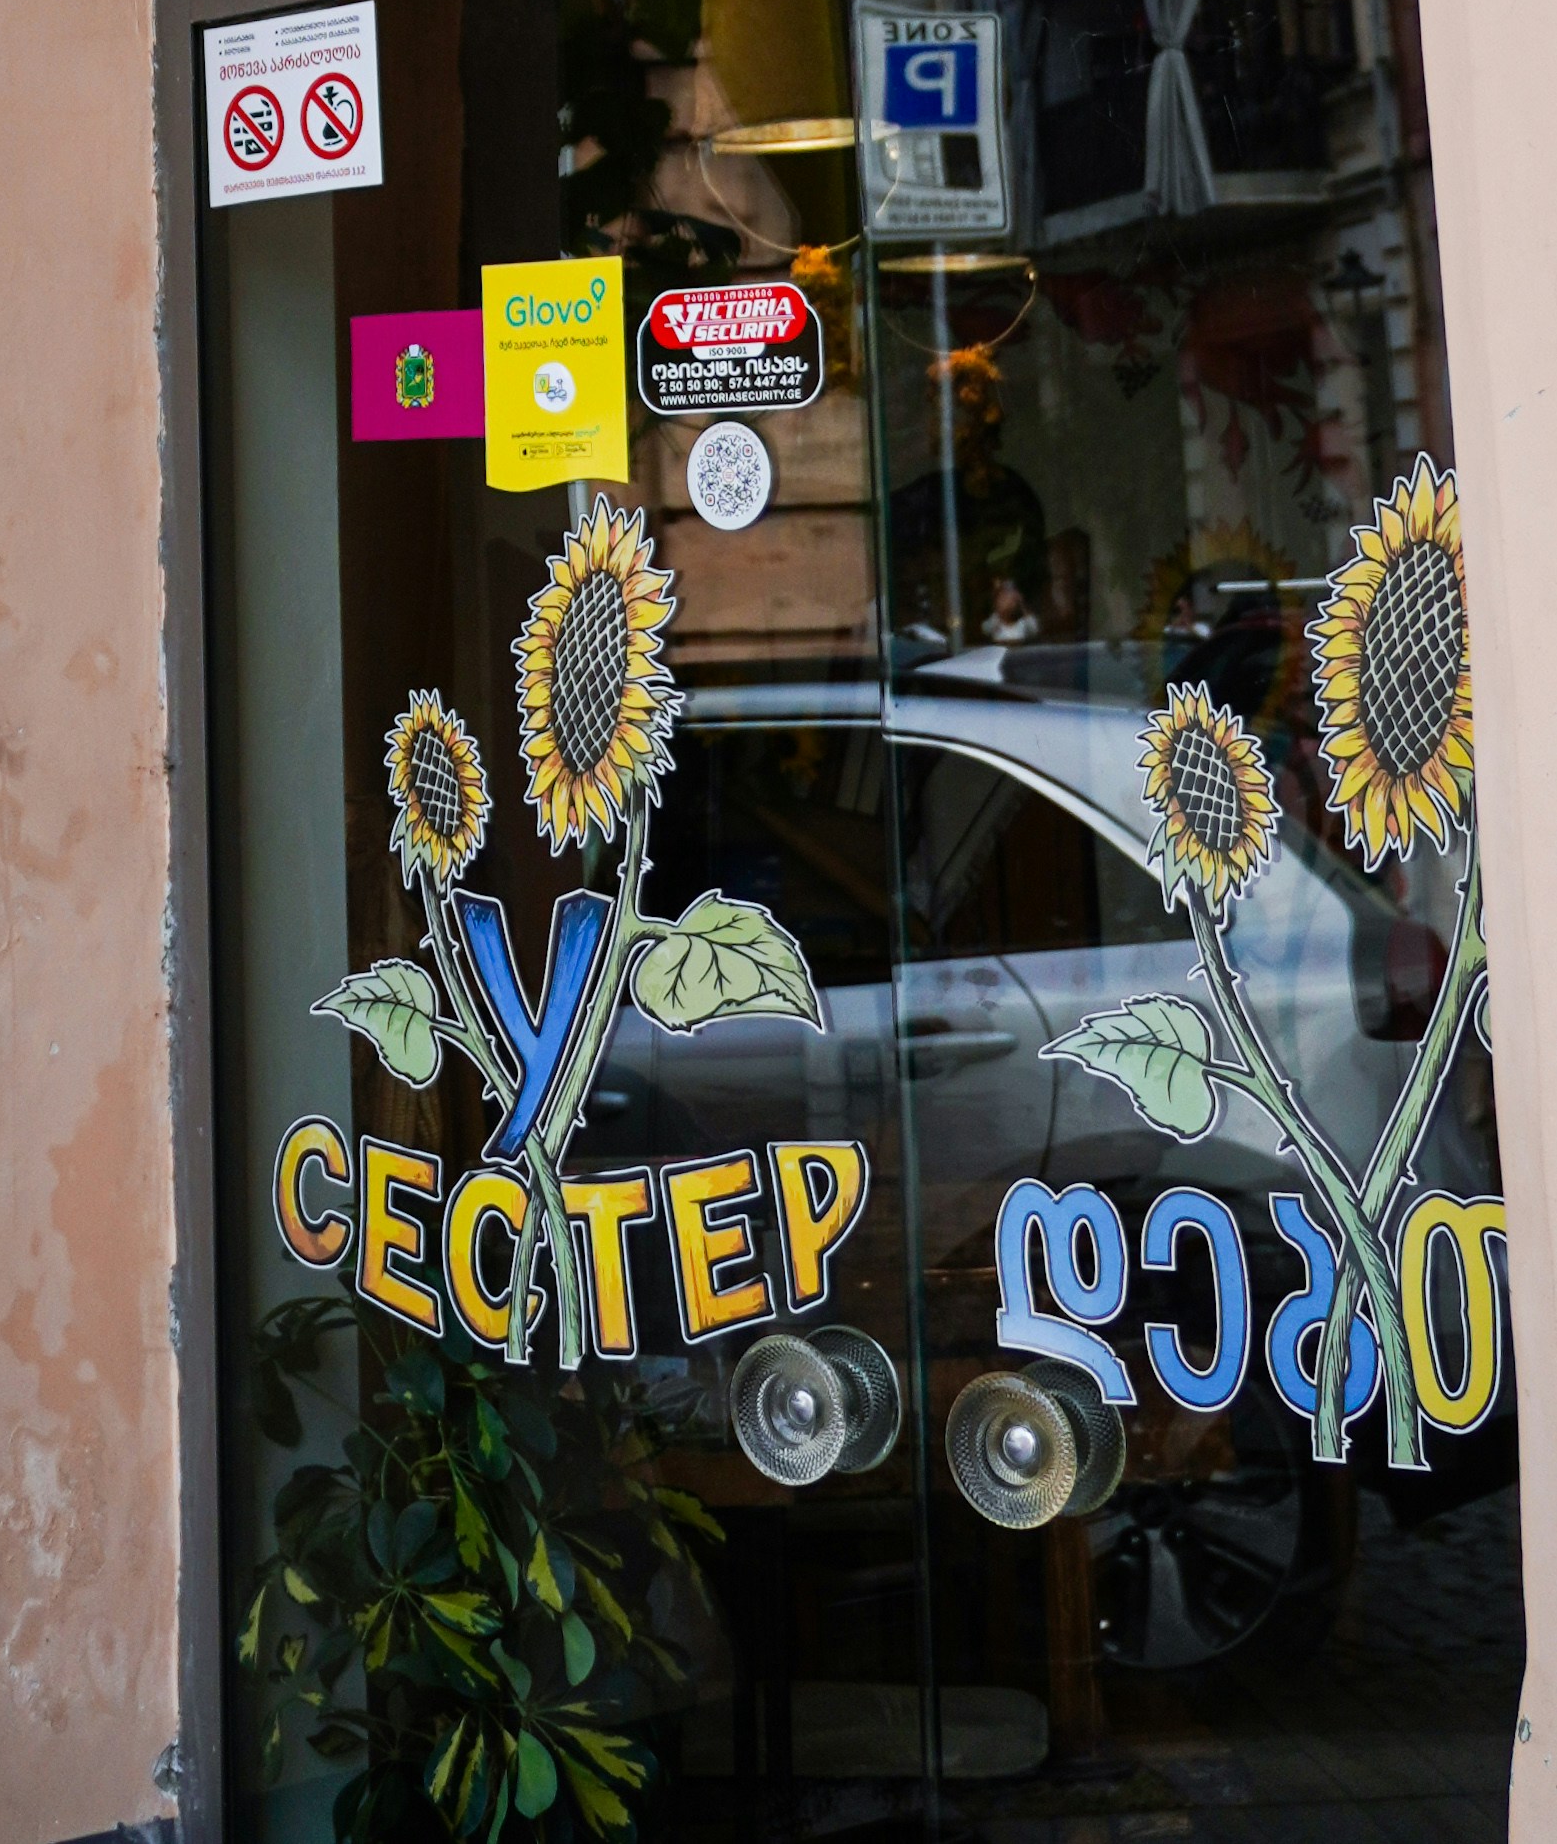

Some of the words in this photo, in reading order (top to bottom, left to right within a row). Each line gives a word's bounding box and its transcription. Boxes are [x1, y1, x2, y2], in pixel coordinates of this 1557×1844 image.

[220, 61, 267, 81] მოწევა
[270, 44, 361, 73] აკრძალულია
[352, 165, 366, 176] 112
[505, 294, 593, 327] Glovo
[662, 296, 792, 343] VICTORIA
[694, 320, 791, 342] SECURITY
[709, 346, 724, 357] ISO
[726, 345, 748, 356] 9001
[651, 360, 741, 381] ობიექტს
[745, 355, 809, 374] იცავს
[658, 381, 667, 393] 2
[669, 380, 683, 392] 50
[687, 379, 701, 391] 50
[728, 376, 751, 389] 574
[753, 375, 775, 388] 447
[779, 373, 802, 387] 447
[660, 388, 802, 407] WWW.VICTORIASECURITY.GE
[272, 1114, 871, 1363] СЕСТЕР
